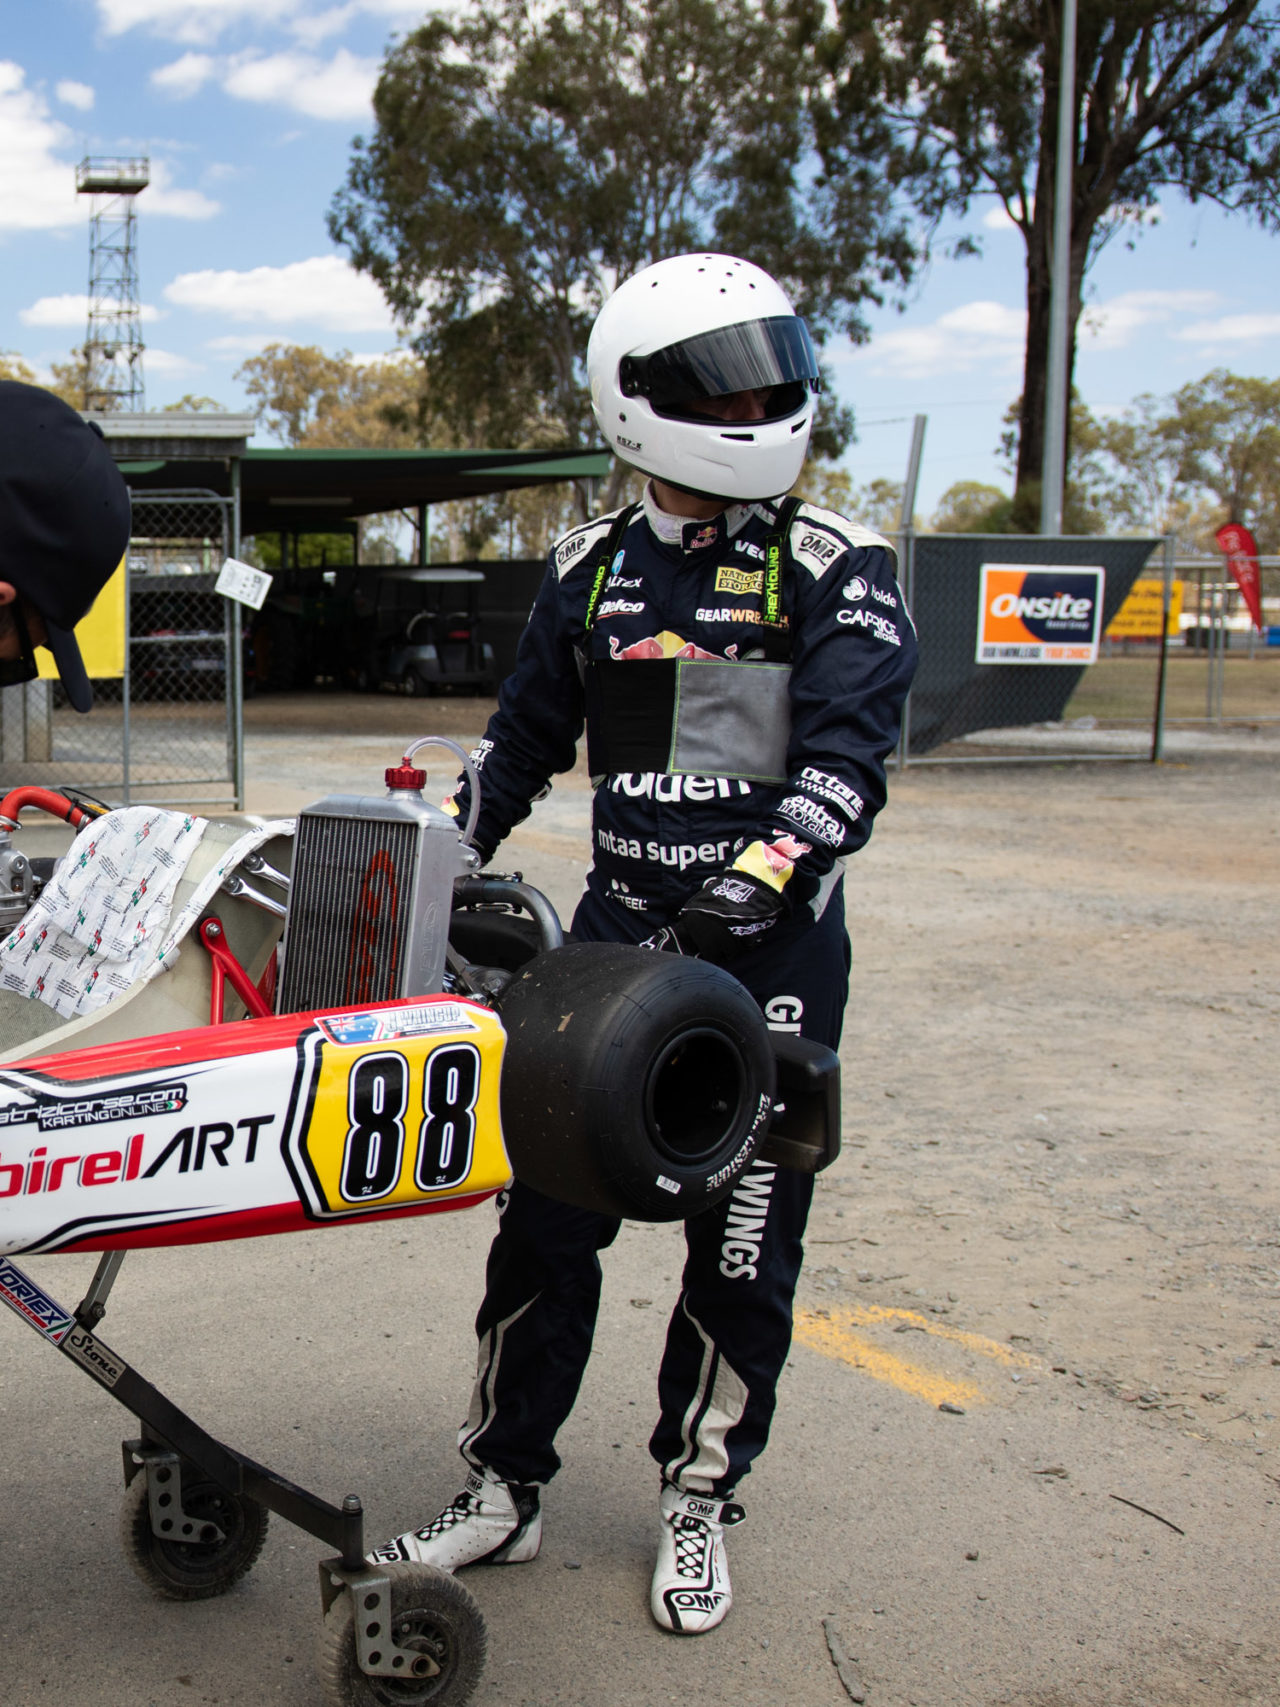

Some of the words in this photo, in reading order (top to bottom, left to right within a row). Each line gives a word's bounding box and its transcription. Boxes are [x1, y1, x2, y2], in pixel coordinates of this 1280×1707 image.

[557, 537, 586, 564] OMP
[800, 535, 836, 560] OMP
[720, 579, 763, 593] STORAG
[870, 583, 897, 609] Holde
[836, 608, 897, 634] CAPRICE
[800, 766, 865, 815] octane
[598, 828, 642, 860] mtaa
[646, 840, 730, 872] super
[41, 1101, 166, 1129] KARTINGONLINE
[339, 1041, 482, 1204] 88
[720, 1171, 776, 1281] WINGS
[70, 1334, 118, 1380] Stone
[687, 1501, 714, 1516] OMP
